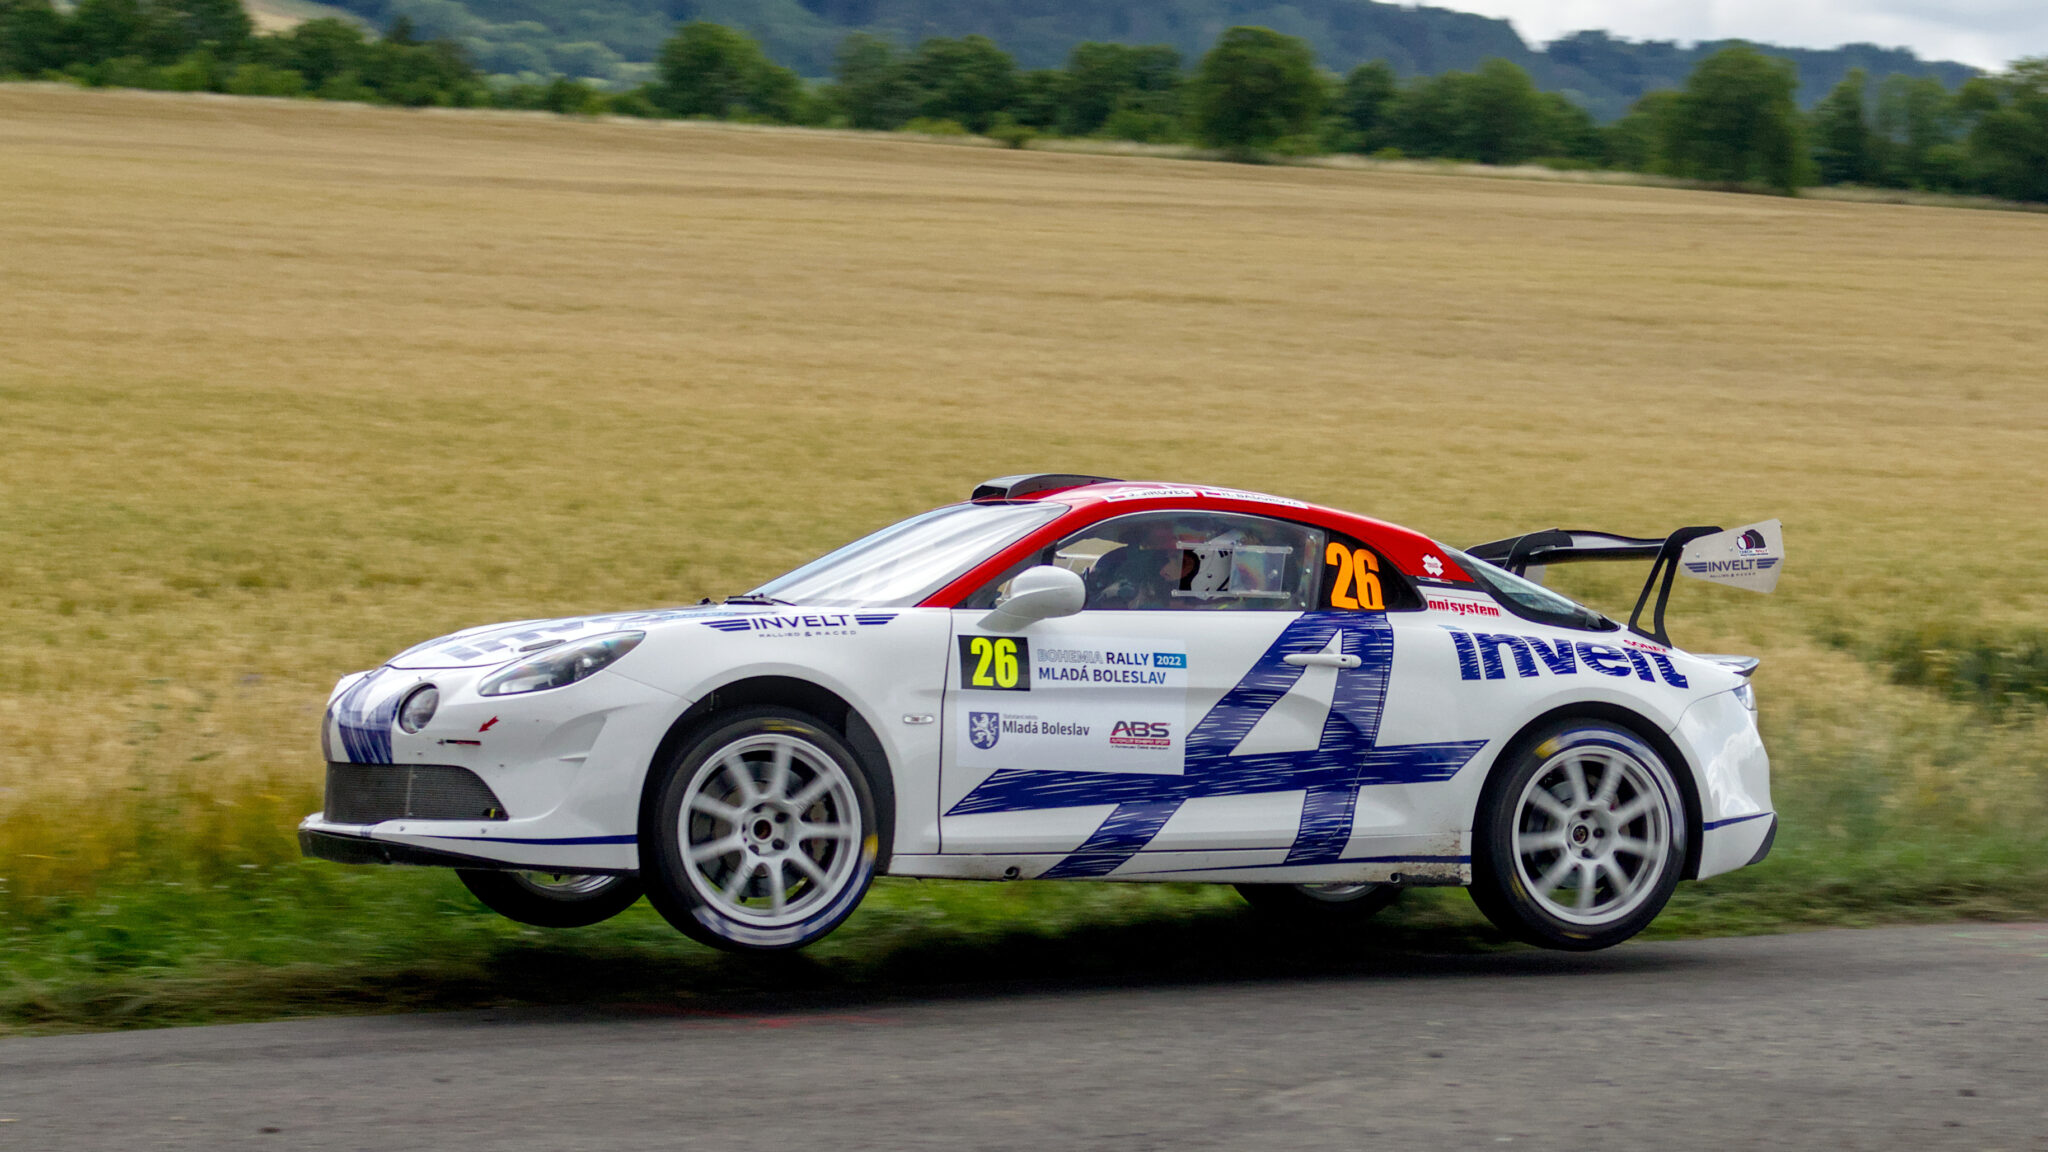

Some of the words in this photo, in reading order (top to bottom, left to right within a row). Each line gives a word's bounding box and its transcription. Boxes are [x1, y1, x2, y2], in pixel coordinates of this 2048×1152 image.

[1708, 559, 1756, 572] INVELT
[1326, 542, 1385, 609] 26
[752, 614, 850, 630] INVELT
[970, 637, 1019, 689] 26
[1037, 649, 1104, 665] BOHEMIA
[1106, 652, 1149, 666] RALLY
[1156, 655, 1182, 666] 2022
[1038, 665, 1089, 682] MLADÁ
[1093, 669, 1167, 684] BOLESLAV
[1002, 720, 1039, 734] Mladá
[1041, 721, 1090, 736] Boleslav
[1111, 721, 1170, 738] ABS
